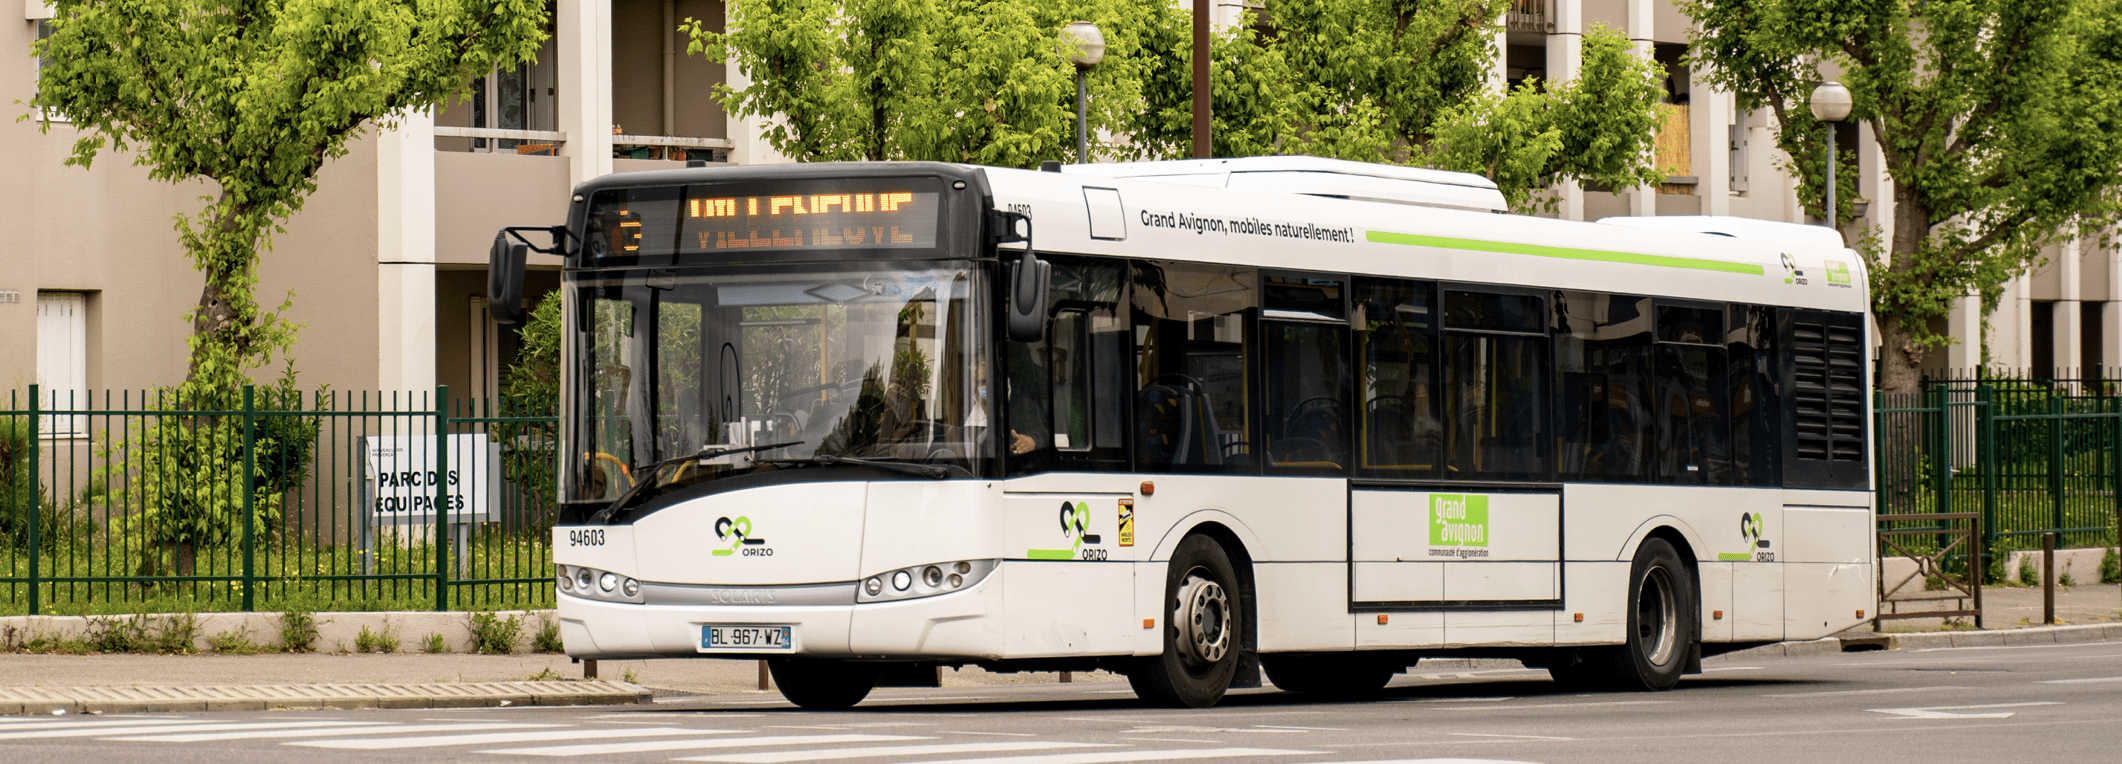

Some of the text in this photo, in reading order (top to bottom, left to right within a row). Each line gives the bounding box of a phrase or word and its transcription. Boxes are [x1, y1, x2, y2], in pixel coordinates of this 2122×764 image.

[1140, 209, 1175, 228] Grand
[1178, 212, 1228, 236] Avignon,
[1229, 217, 1272, 236] mobiles
[380, 471, 422, 487] PARC
[427, 470, 459, 487] DS
[1435, 494, 1466, 524] grand
[570, 529, 605, 546] 94603
[1441, 519, 1484, 546] avignon
[742, 548, 774, 556] ORIZO
[1082, 549, 1108, 560] ORIZO
[1756, 551, 1775, 562] ORIZO
[711, 589, 776, 604] SOLARIS
